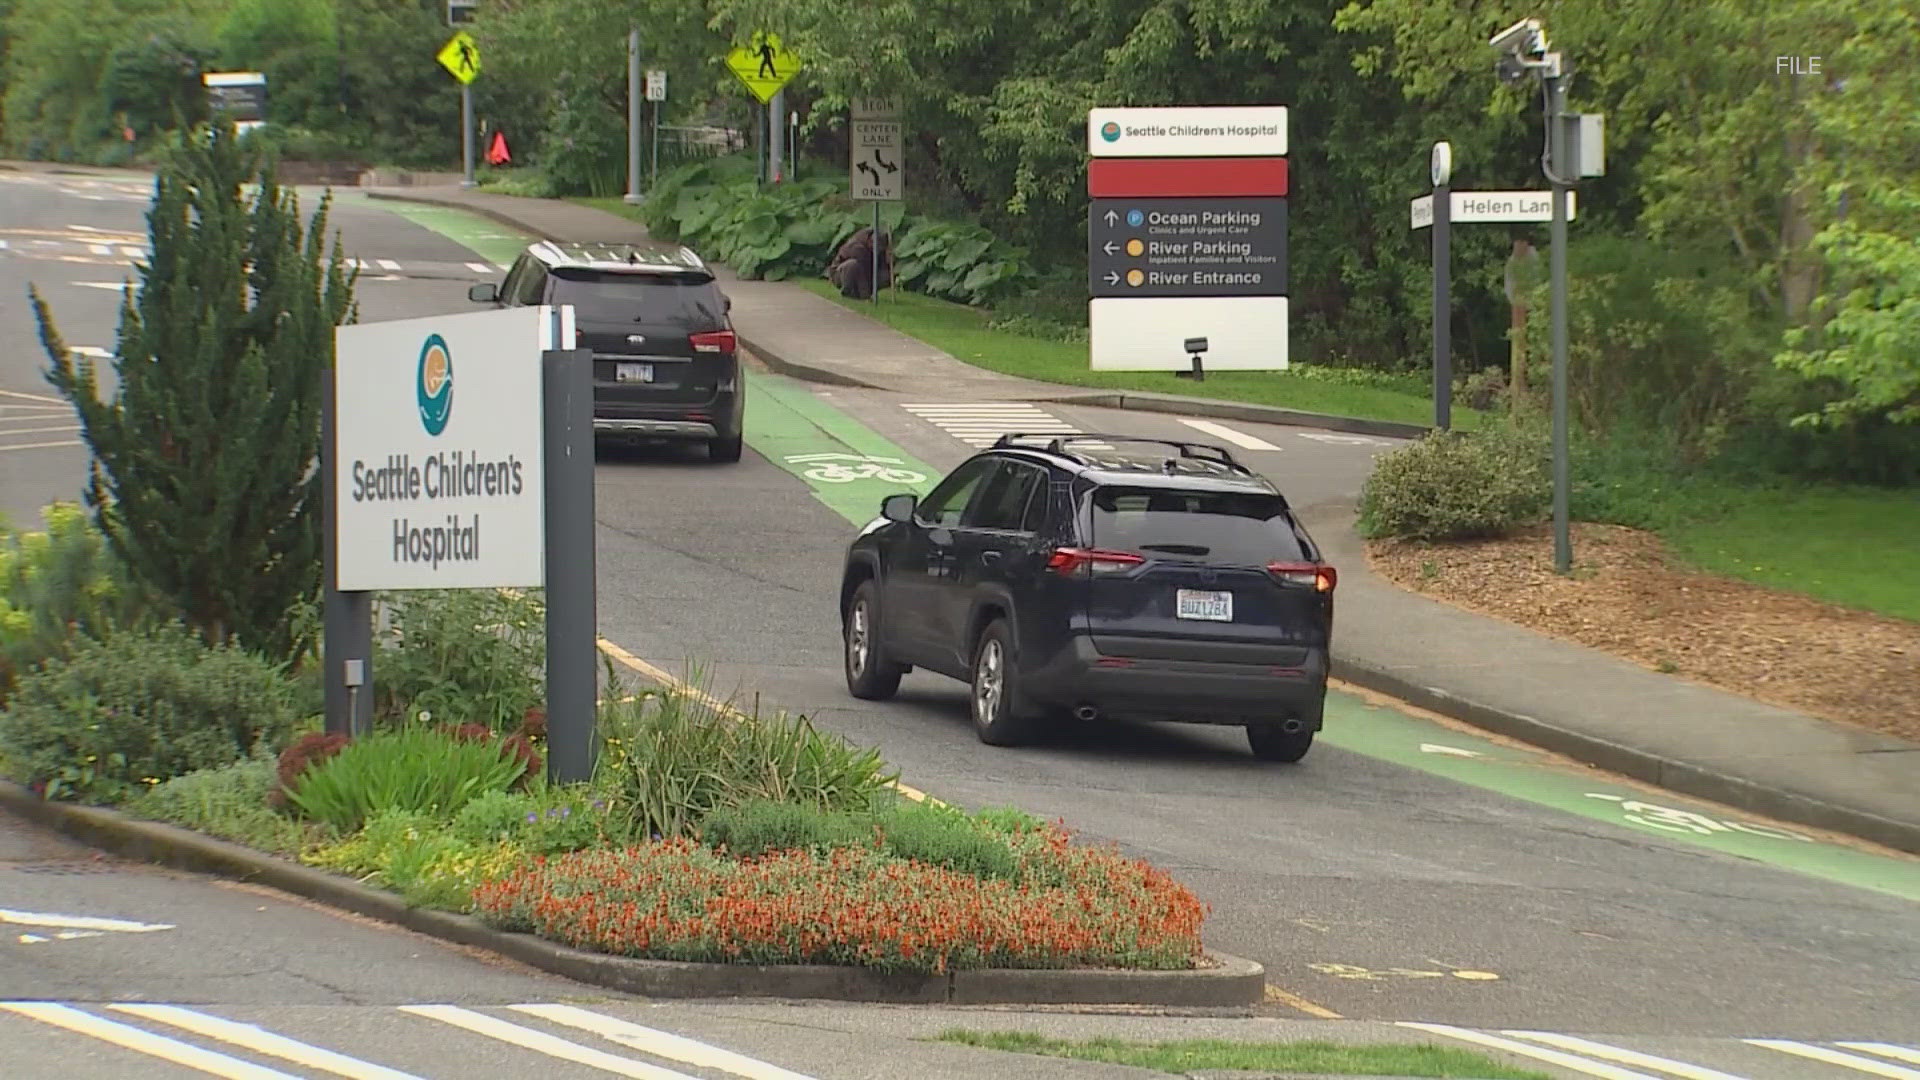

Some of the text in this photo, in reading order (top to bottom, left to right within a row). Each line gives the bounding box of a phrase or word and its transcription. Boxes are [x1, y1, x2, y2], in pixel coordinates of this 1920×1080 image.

[651, 86, 663, 98] 10
[862, 100, 894, 112] BEGIN
[856, 124, 898, 133] CENTER
[1126, 125, 1278, 137] Seattle Children's Hospital
[863, 135, 891, 143] LANE
[862, 188, 891, 197] ONLY
[1462, 199, 1551, 214] Helen Lan
[1148, 211, 1261, 226] Ocean Parking
[1148, 226, 1248, 235] Clinics and Urgent Care
[1149, 241, 1251, 256] River Parking
[1149, 255, 1277, 264] Inpatient Families and Visitors
[1149, 271, 1262, 284] River Entrance
[352, 450, 523, 502] Seattle Children's
[393, 513, 480, 571] Hospital
